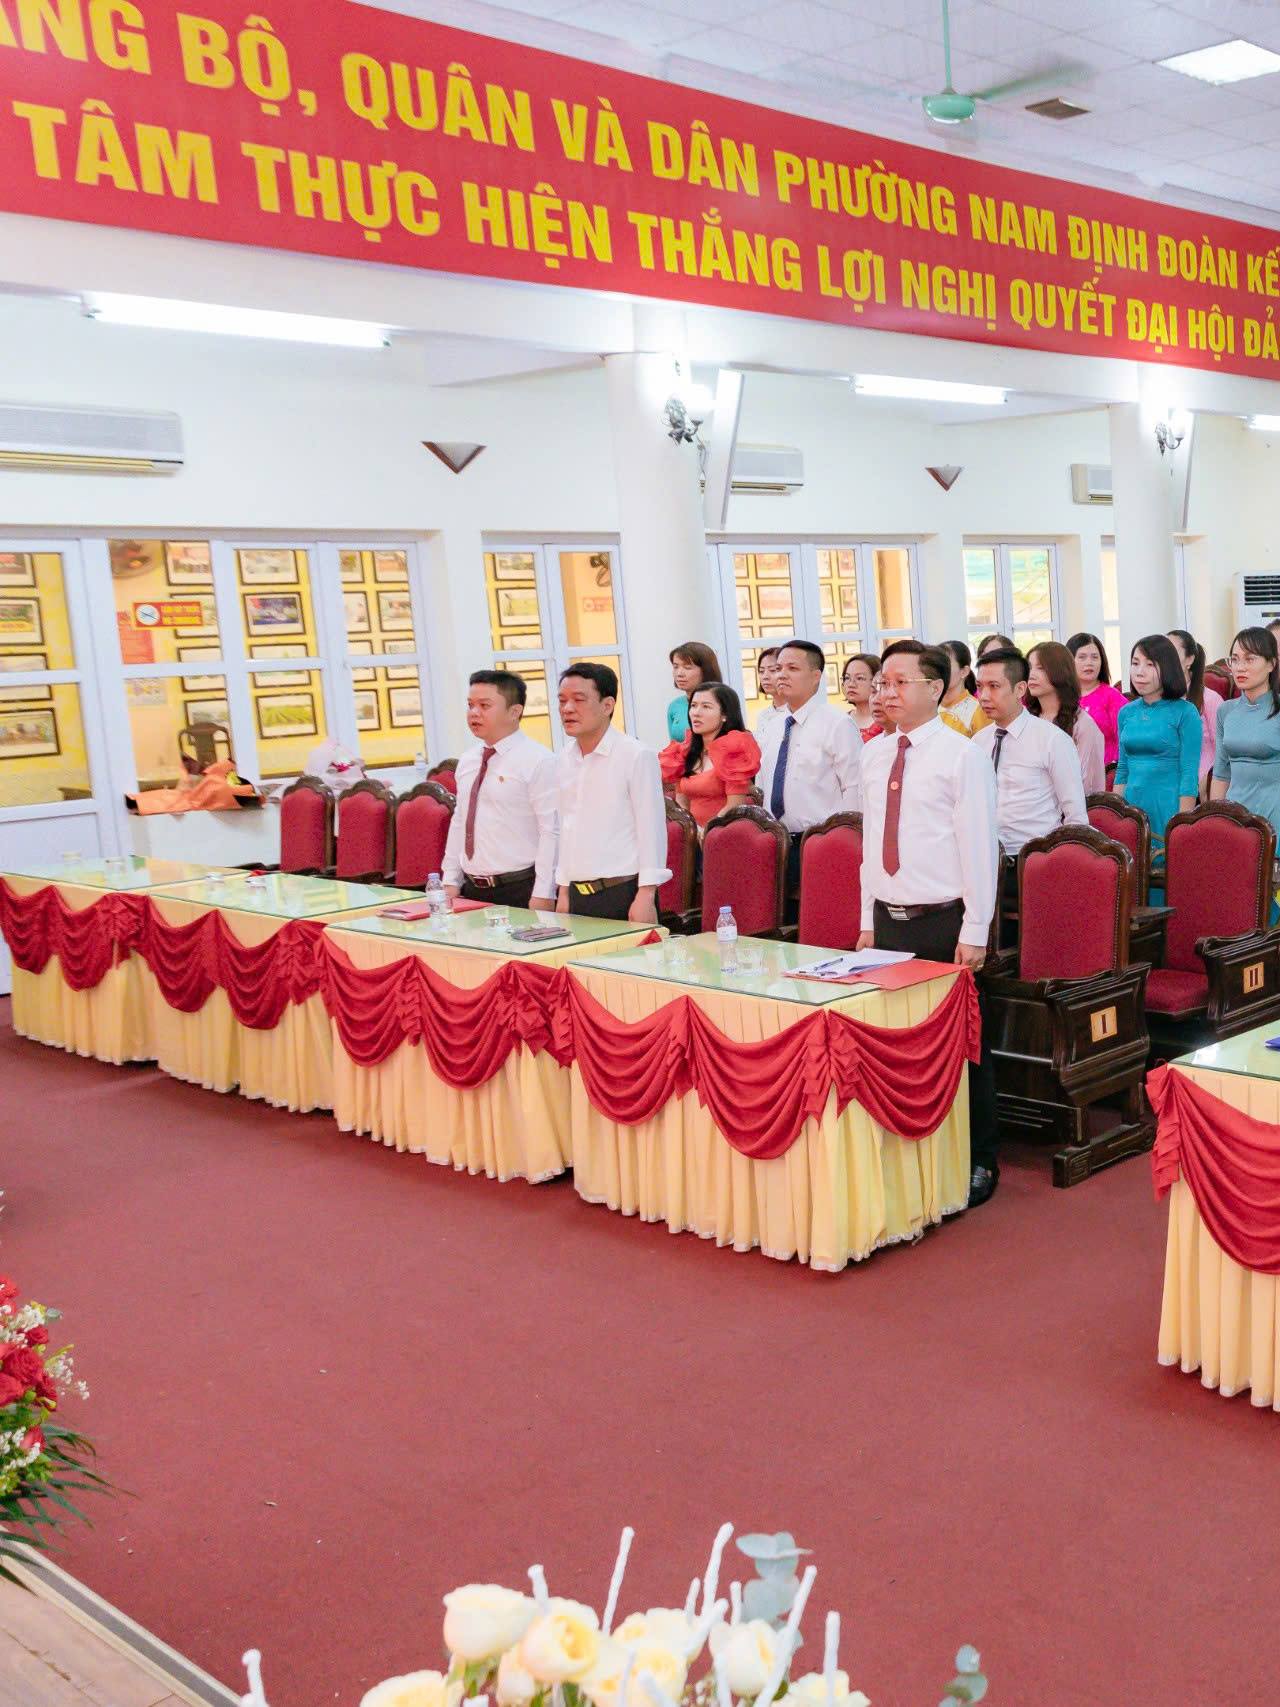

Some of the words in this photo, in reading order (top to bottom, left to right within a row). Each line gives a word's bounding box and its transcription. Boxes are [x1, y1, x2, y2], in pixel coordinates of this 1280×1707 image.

[0, 0, 152, 75] NG
[176, 14, 319, 117] BỘ,
[340, 53, 536, 152] QUÂN
[551, 96, 634, 172] VÀ
[647, 119, 761, 197] DÂN
[773, 150, 959, 236] PHƯỜNG
[968, 193, 1058, 255] NAM
[1067, 214, 1149, 274] ĐỊNH
[1156, 235, 1238, 289] ĐOÀN
[12, 99, 219, 205] TÂM
[240, 142, 441, 243] THỰC
[461, 181, 614, 269] HIỆN
[626, 207, 804, 293] THẮNG
[816, 245, 887, 313] LỢI
[900, 259, 998, 332] NGHỊ
[1009, 276, 1118, 338] QUYẾT
[1125, 298, 1180, 354] ĐẠI
[1187, 303, 1235, 362] HỘI
